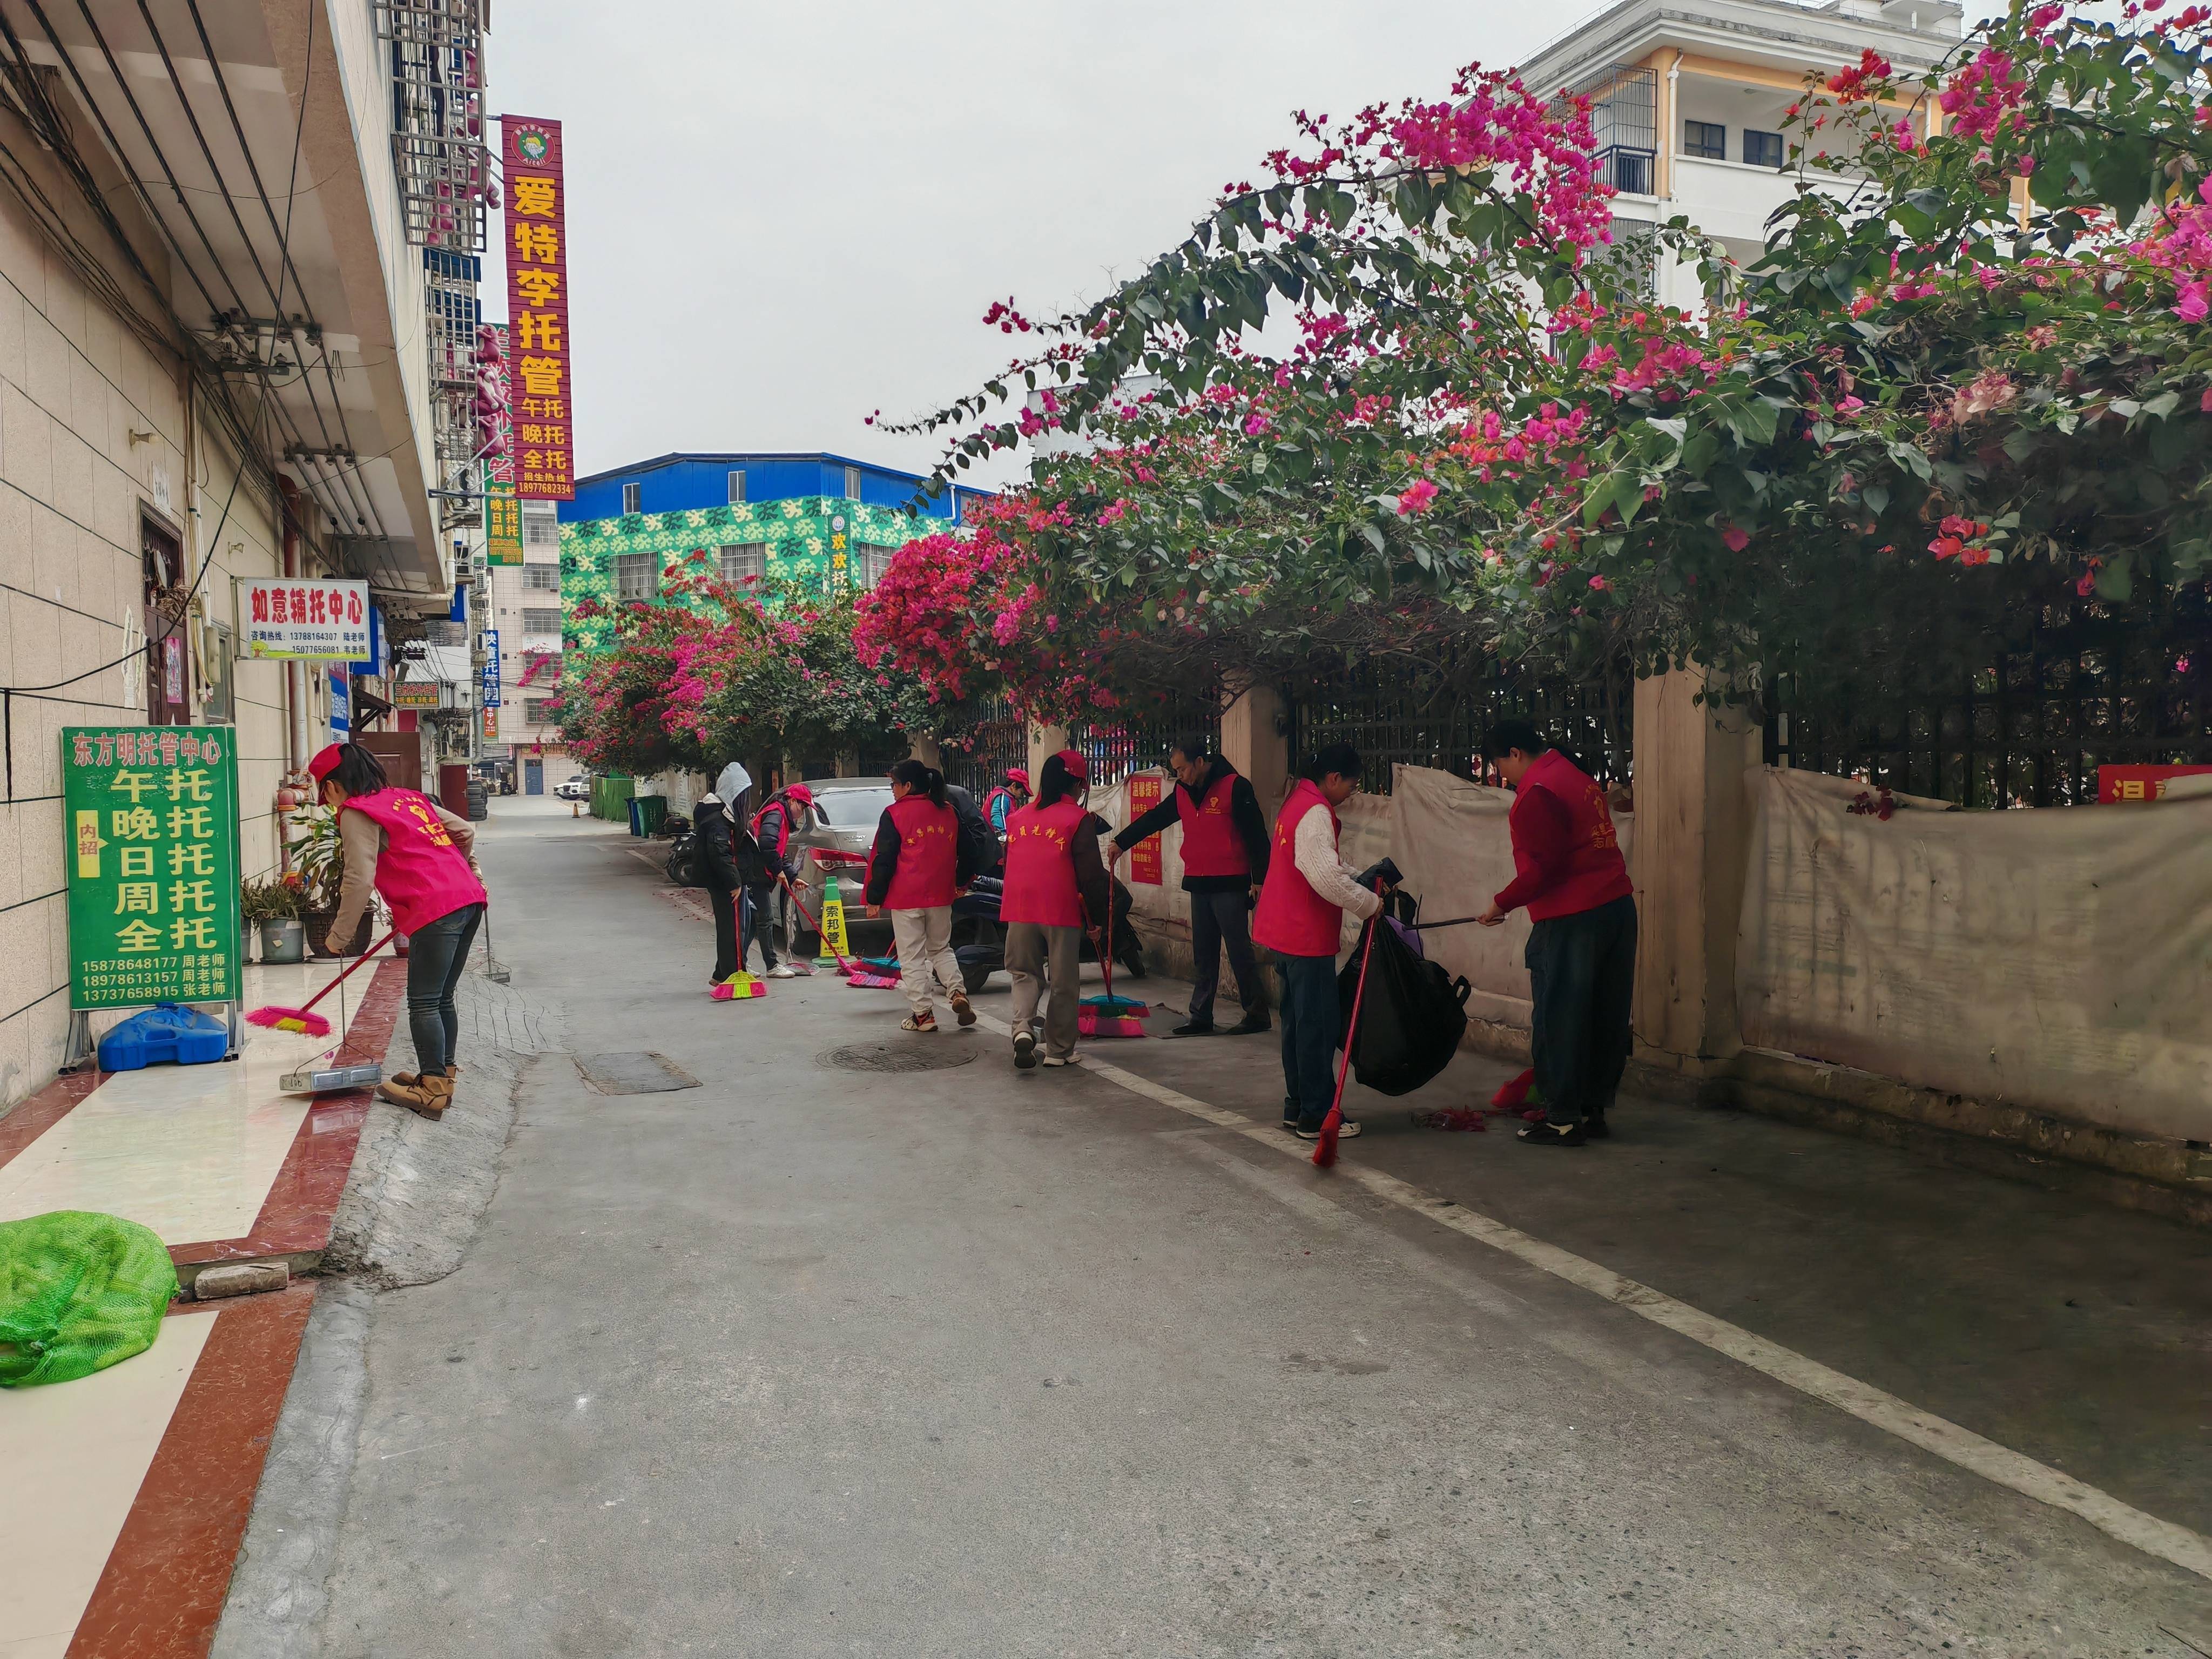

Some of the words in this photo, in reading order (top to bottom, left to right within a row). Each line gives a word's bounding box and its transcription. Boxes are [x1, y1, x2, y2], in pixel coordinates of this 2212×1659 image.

[514, 176, 562, 395] 爱特李托管
[521, 397, 564, 418] 午托
[522, 424, 565, 444] 晚托
[523, 449, 567, 469] 全托
[524, 472, 567, 482] 招生热线
[519, 482, 571, 494] 18977682334
[490, 499, 518, 511] 晚托
[492, 512, 518, 524] 日托
[491, 525, 518, 537] 周托
[251, 586, 362, 625] 如意辅托中心
[251, 631, 286, 641] 咨询热线:
[291, 632, 337, 640] 13788164307
[343, 632, 365, 642] 陆老师
[293, 646, 339, 654] 15077656081
[343, 645, 366, 655] 韦老师
[72, 732, 222, 767] 东方明托管中心
[111, 768, 213, 803] 午托
[112, 806, 214, 840] 晚托
[79, 824, 98, 855] 内招
[121, 843, 215, 877] 日托
[114, 880, 216, 915] 周托
[114, 916, 217, 952] 全托
[826, 906, 840, 943] 索邦管
[82, 957, 177, 972] 15878648177
[183, 953, 225, 968] 周老师
[83, 971, 178, 987] 18978613157
[183, 968, 226, 982] 周老师
[83, 986, 179, 1001] 13737658915
[184, 982, 226, 996] 张老师
